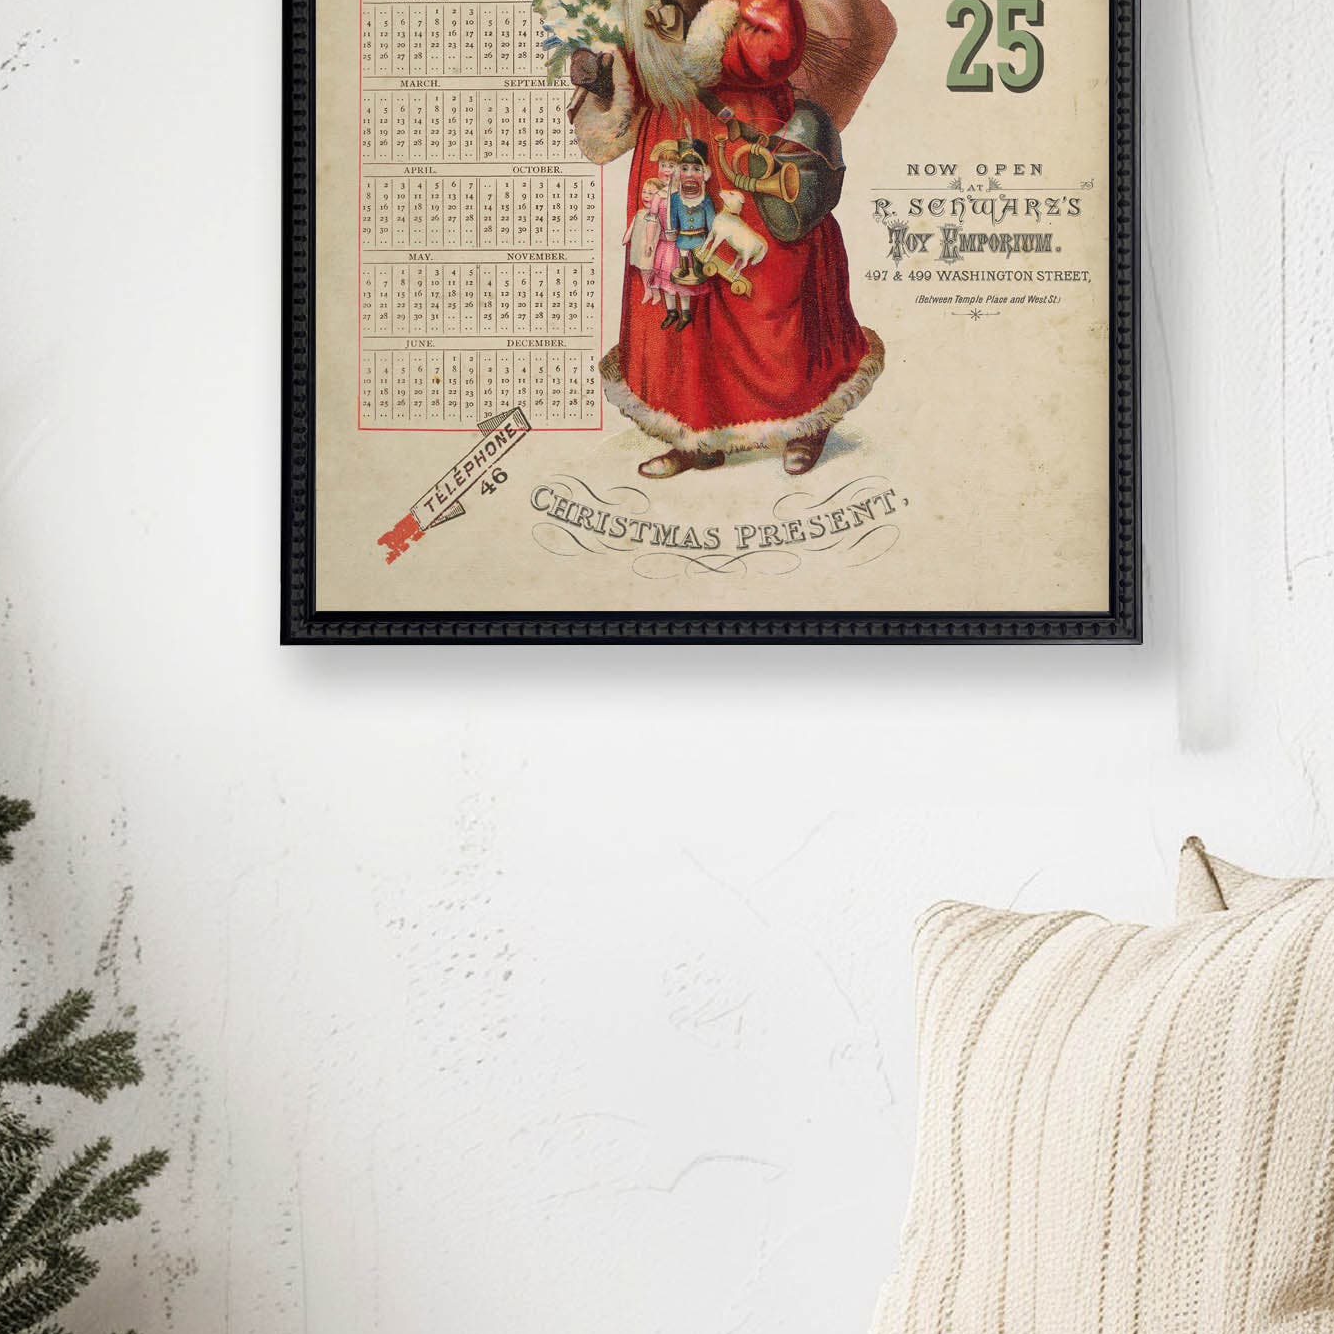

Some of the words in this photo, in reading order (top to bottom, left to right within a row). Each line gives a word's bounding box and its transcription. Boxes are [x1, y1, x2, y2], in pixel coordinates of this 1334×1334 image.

[400, 79, 441, 88] MARCH.
[414, 118, 423, 126] 14
[432, 118, 440, 126] 15
[465, 118, 474, 126] 17
[363, 127, 372, 136] 18
[448, 129, 457, 137] 23
[465, 129, 474, 137] 24
[403, 166, 437, 174] APRIL.
[512, 166, 563, 174] OCTOBER.
[907, 163, 958, 176] NOW
[976, 163, 1043, 176] OPEN
[966, 183, 984, 192] AT
[587, 193, 596, 201] 13
[363, 205, 372, 213] 15
[380, 203, 389, 211] 16
[398, 205, 406, 213] 17
[414, 203, 423, 211] 18
[484, 204, 493, 212] 14
[501, 204, 510, 212] 15
[518, 203, 527, 211] 16
[553, 203, 563, 211] 18
[380, 216, 389, 224] 23
[396, 216, 406, 224] 24
[414, 216, 423, 224] 25
[431, 214, 440, 222] 26
[448, 216, 458, 224] 27
[465, 214, 475, 222] 28
[570, 214, 579, 222] 26
[379, 227, 389, 235] 30
[484, 225, 493, 233] 28
[501, 227, 510, 235] 29
[518, 227, 528, 235] 30
[535, 227, 544, 235] 31
[886, 222, 935, 264] TOY
[408, 252, 434, 261] MAY.
[506, 252, 568, 261] NOVEMBER.
[864, 270, 888, 282] 497
[892, 270, 903, 282] &
[907, 270, 932, 282] 499
[936, 270, 1034, 282] WASHINGTON
[1036, 270, 1092, 284] STREET,
[518, 291, 527, 299] 13
[535, 291, 544, 299] 14
[553, 291, 562, 299] 15
[587, 291, 595, 299] 17
[915, 295, 953, 304] (Between
[955, 295, 983, 305] Temple
[985, 295, 1008, 304] Place
[1010, 295, 1026, 304] and
[484, 301, 493, 309] 18
[501, 302, 510, 310] 19
[569, 302, 578, 310] 23
[380, 312, 389, 320] 28
[397, 314, 406, 322] 29
[414, 314, 424, 322] 30
[501, 312, 510, 320] 26
[535, 311, 544, 320] 28
[405, 339, 435, 348] JUNE.
[506, 339, 567, 348] DECEMBER.
[423, 422, 518, 513] TÉLÉPHONE
[479, 466, 509, 496] 46
[530, 483, 722, 551] CHRISTMAS
